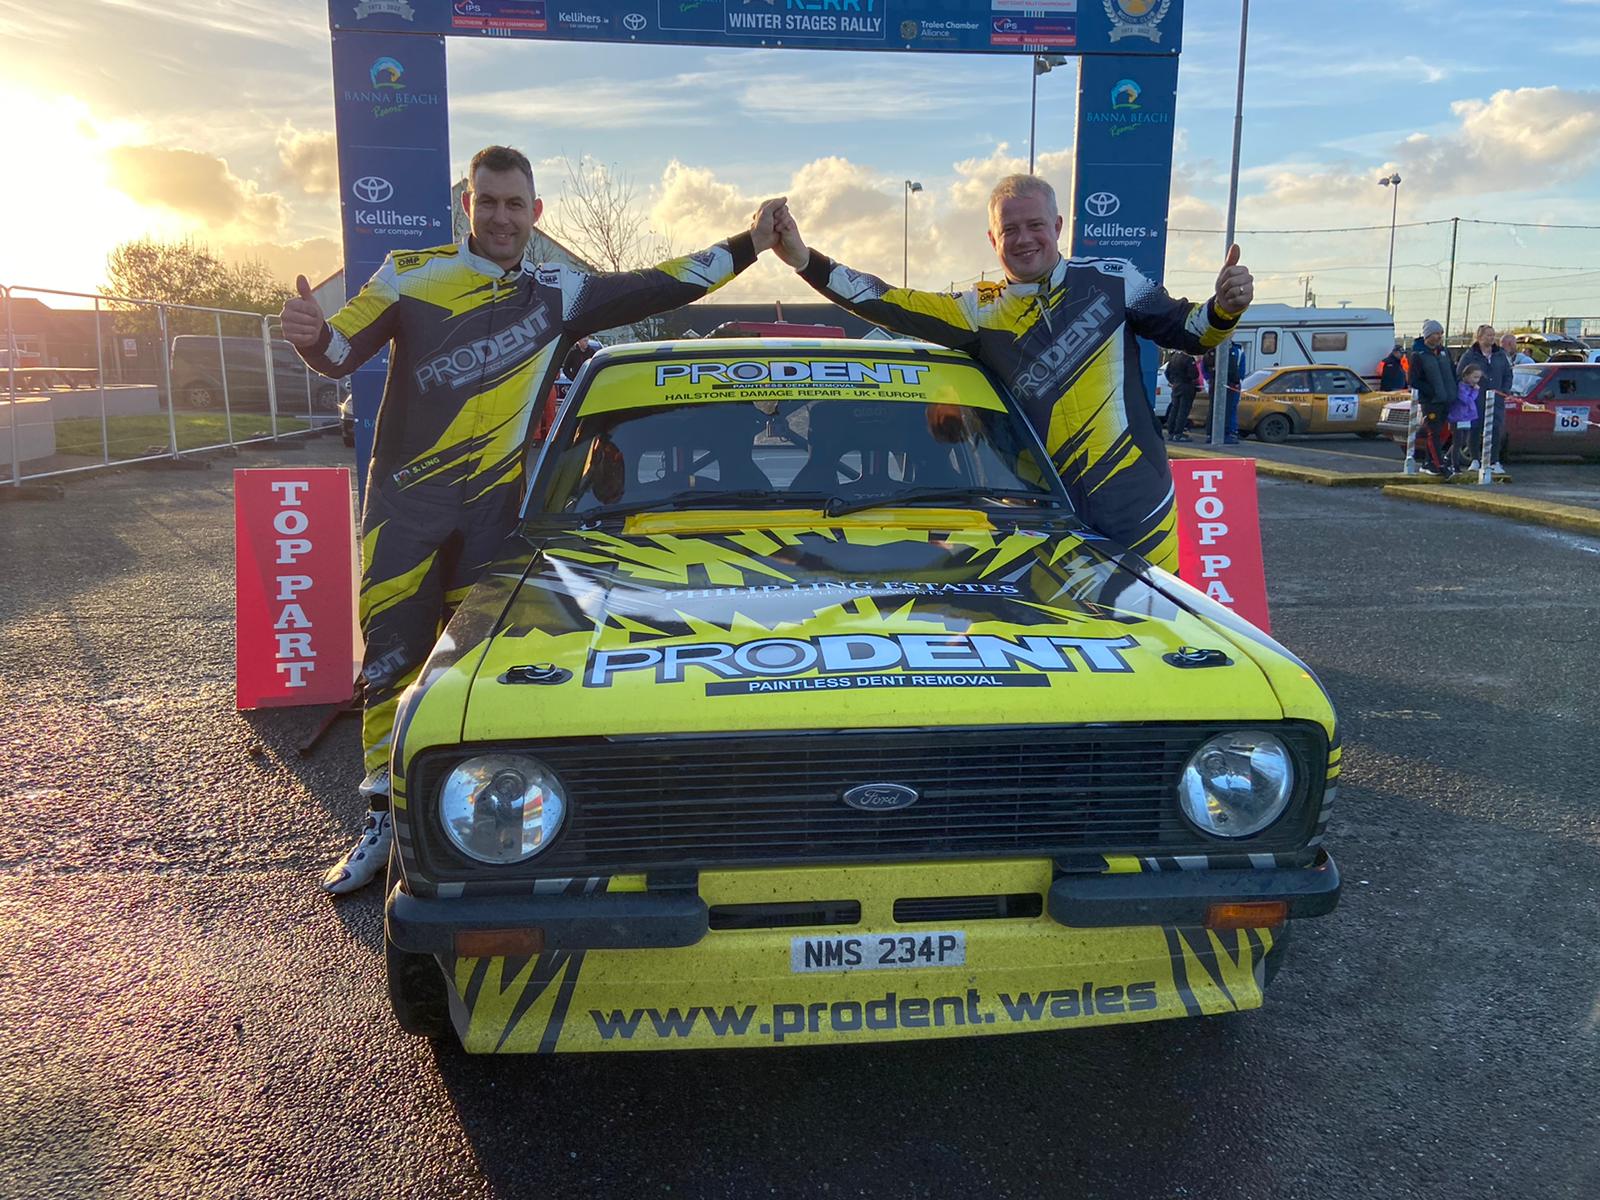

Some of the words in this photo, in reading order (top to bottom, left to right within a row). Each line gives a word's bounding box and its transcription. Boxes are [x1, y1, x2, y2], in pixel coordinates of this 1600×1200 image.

[465, 4, 481, 13] IPS
[558, 11, 602, 24] Kellihers
[729, 13, 782, 29] WINTER
[786, 14, 837, 31] STAGES
[841, 16, 881, 32] RALLY
[945, 21, 980, 30] Chamber
[1004, 22, 1018, 30] IPS
[344, 90, 391, 104] BANNA
[395, 92, 439, 105] BEACH
[1087, 111, 1126, 122] BANNA
[1130, 112, 1168, 123] BEACH
[355, 209, 427, 226] Kellihers
[387, 228, 424, 238] company
[1083, 222, 1147, 238] Kellihers
[1098, 239, 1110, 247] car
[1110, 239, 1143, 248] company
[398, 256, 420, 267] OMP
[1103, 264, 1124, 272] OMP
[414, 303, 550, 393] PRODENT
[1010, 294, 1113, 402] PRODENT
[655, 361, 930, 387] PRODENT
[732, 382, 784, 390] PAINTLESS
[665, 391, 736, 402] HAILSTONE
[740, 389, 793, 399] DAMAGE
[798, 389, 842, 398] REPAIR
[1192, 470, 1229, 546] TOP
[271, 481, 313, 565] TOP
[791, 581, 872, 593] LING
[881, 581, 1020, 594] ESTATES
[1200, 555, 1235, 612] PA
[273, 575, 317, 688] PART
[584, 633, 1139, 688] PRODENT
[749, 676, 850, 693] PAINTLESS
[857, 675, 907, 687] DENT
[911, 674, 1003, 687] REMOVAL
[860, 789, 901, 805] Ford
[804, 939, 863, 968] NMS
[878, 934, 957, 965] 234P
[588, 981, 1158, 1043] www.prodent.wales
